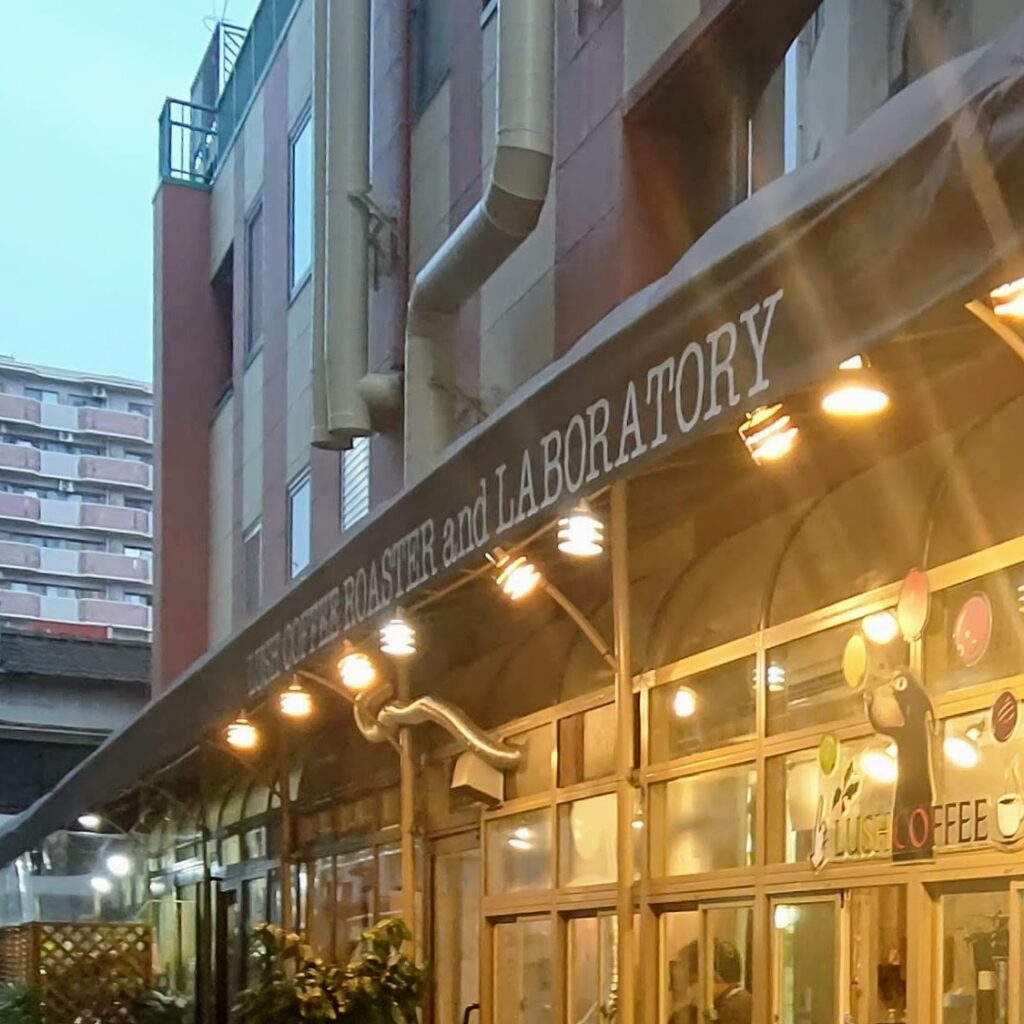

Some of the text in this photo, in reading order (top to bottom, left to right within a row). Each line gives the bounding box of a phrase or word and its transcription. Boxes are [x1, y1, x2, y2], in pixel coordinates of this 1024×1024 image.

[343, 517, 439, 632] ROASTER
[442, 477, 490, 569] and
[495, 288, 785, 535] LABORATORY
[834, 798, 988, 854] LUSH COFFEE
